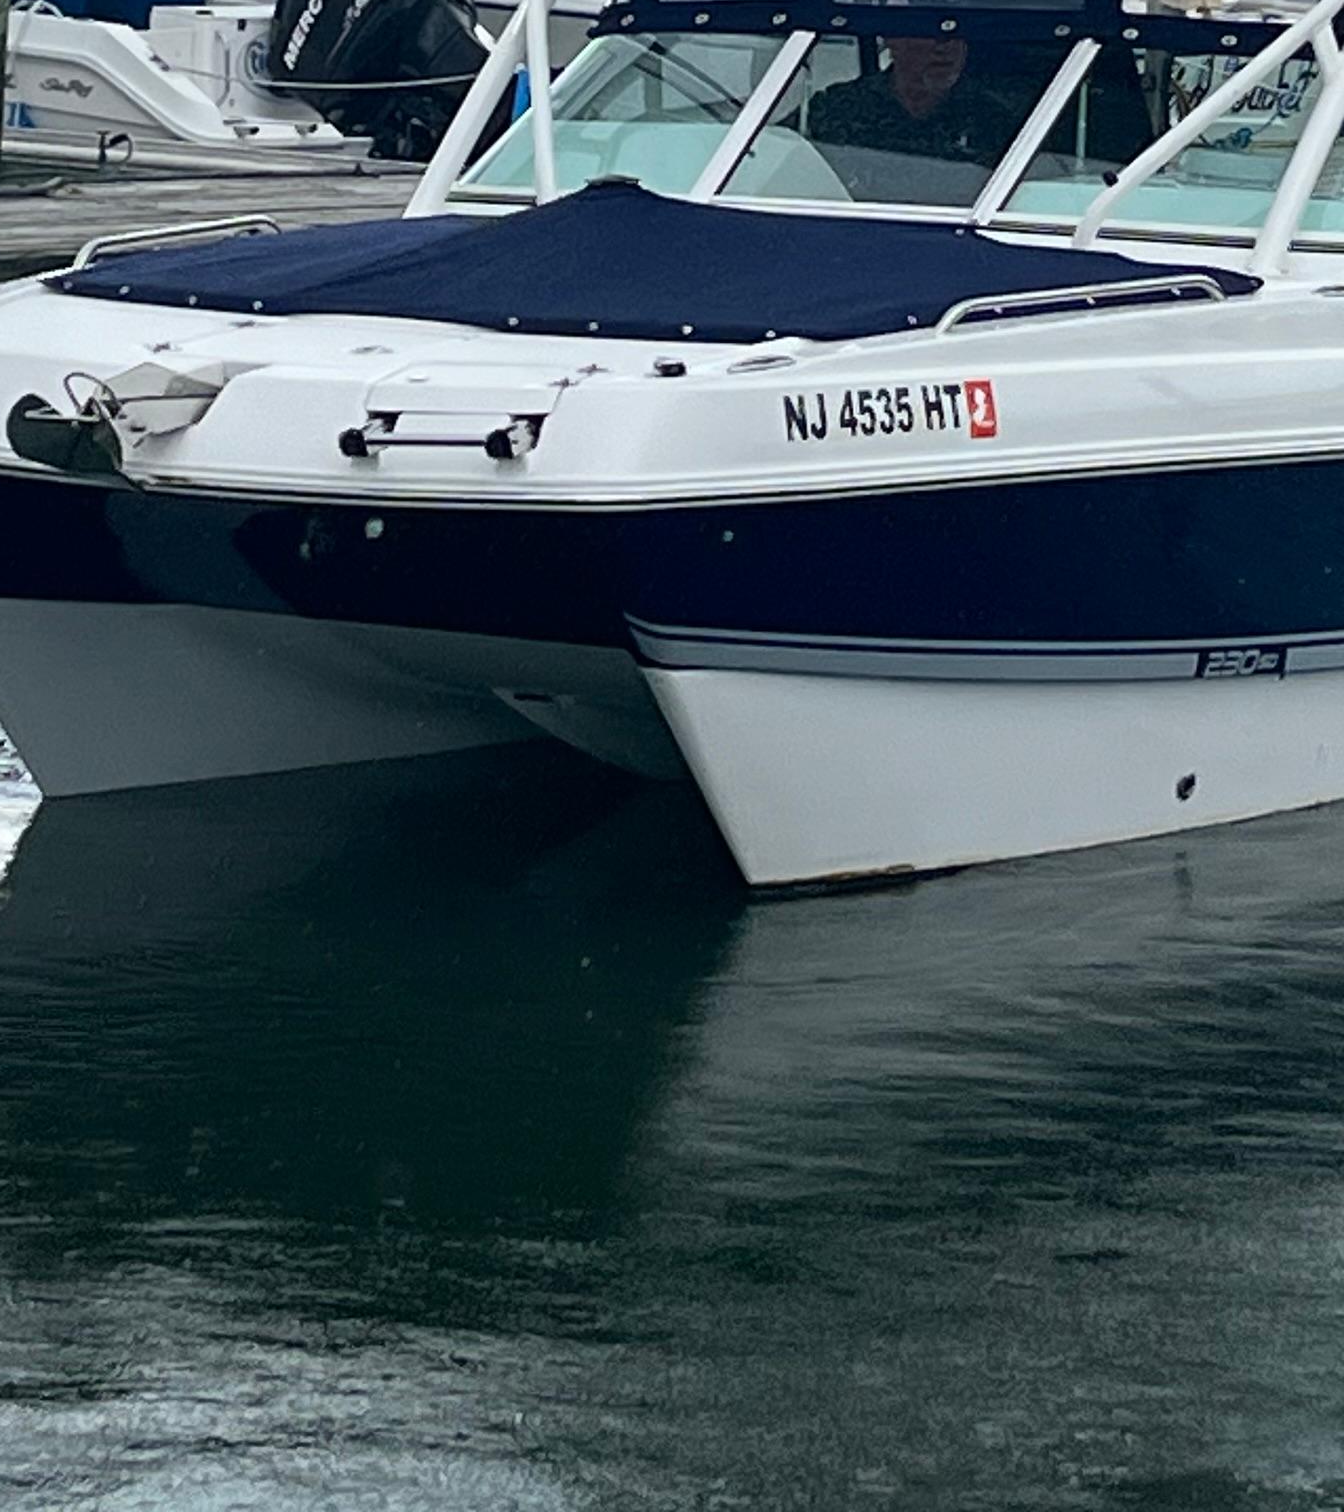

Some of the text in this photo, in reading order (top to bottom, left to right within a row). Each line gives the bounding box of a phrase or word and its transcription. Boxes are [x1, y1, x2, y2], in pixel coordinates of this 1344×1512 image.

[782, 384, 962, 442] NJ 4535 HT
